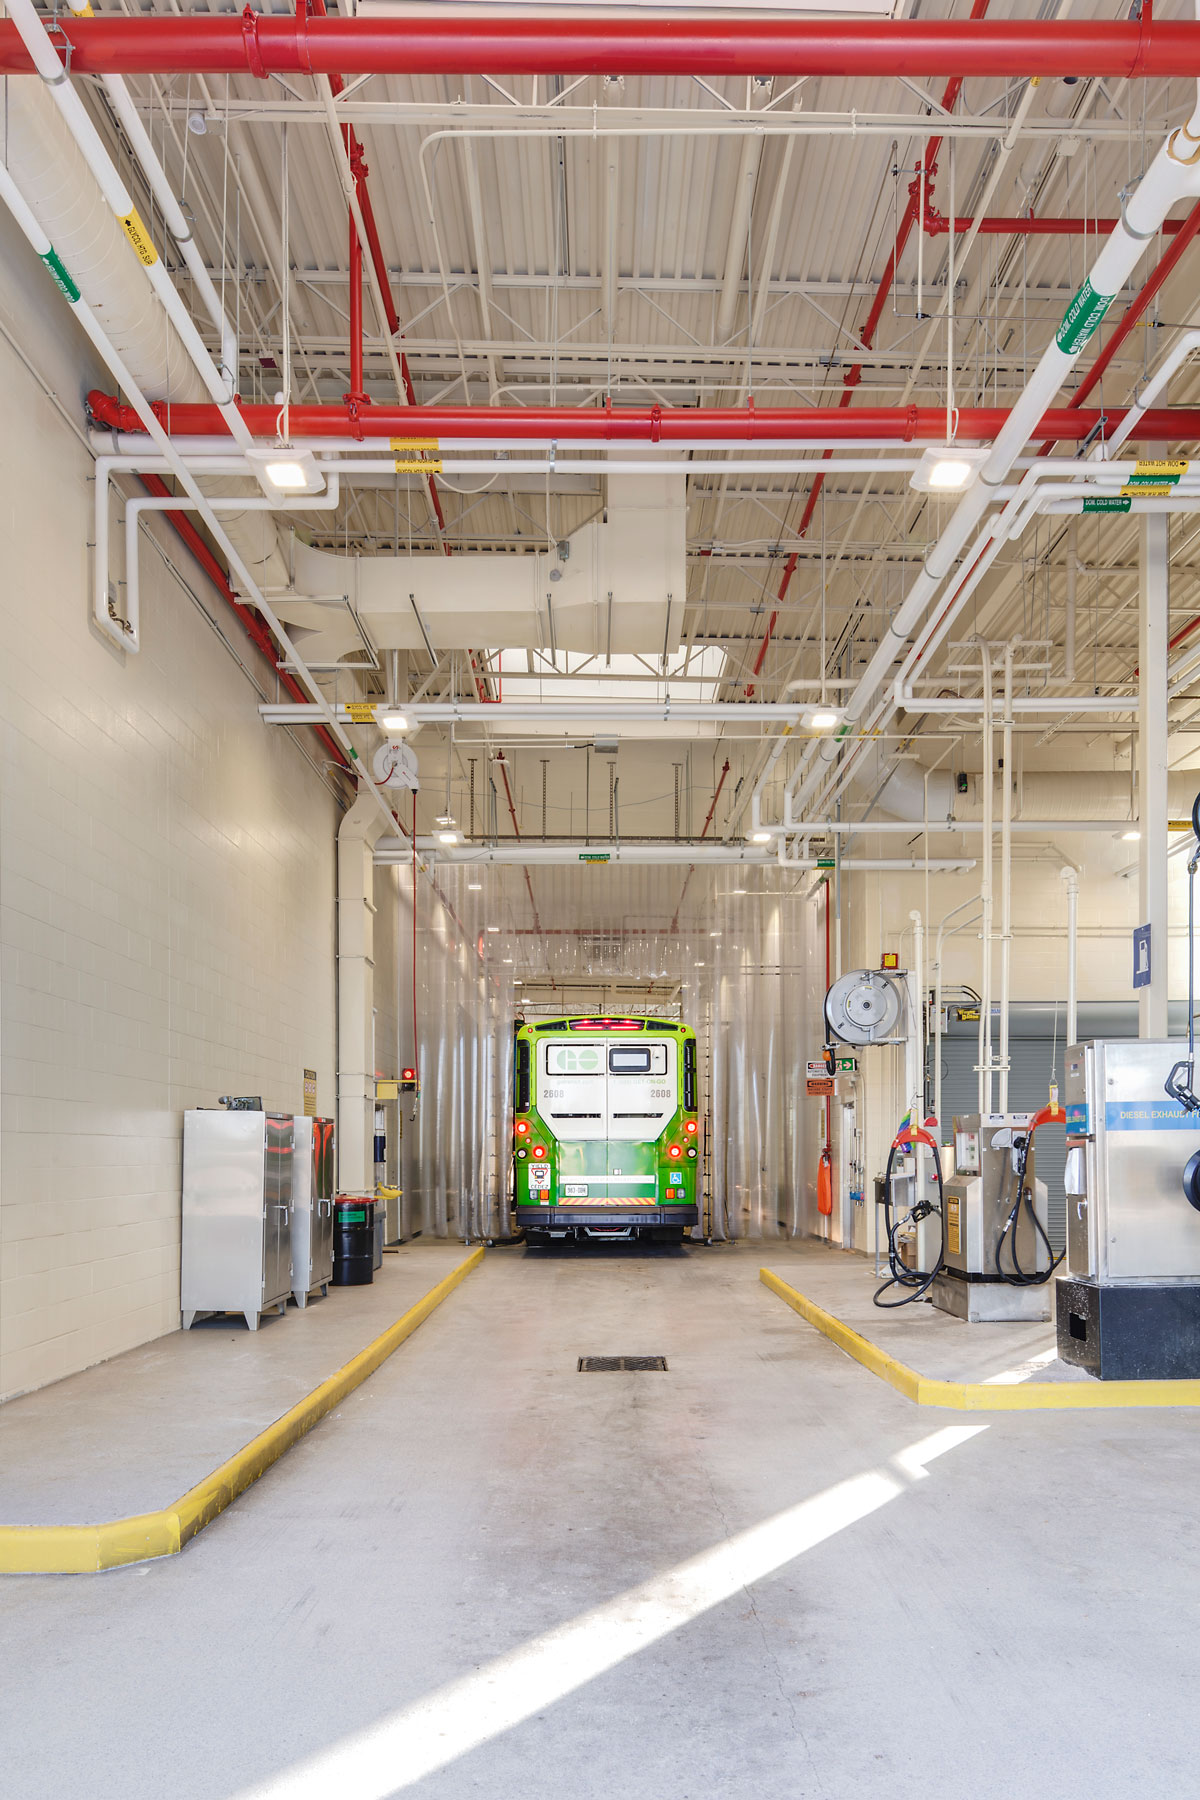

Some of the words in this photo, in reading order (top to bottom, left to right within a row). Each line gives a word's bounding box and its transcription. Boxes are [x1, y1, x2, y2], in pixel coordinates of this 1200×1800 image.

[127, 226, 141, 245] GLYCOL
[142, 255, 153, 265] SUP
[1068, 303, 1080, 323] COLD
[1077, 283, 1092, 308] WATER
[1084, 312, 1101, 328] COLD
[1071, 328, 1092, 346] WATER
[556, 1049, 599, 1070] GO
[543, 1089, 565, 1098] 2608
[650, 1089, 671, 1098] 2608
[1120, 1110, 1148, 1119] DIESEL
[1151, 1110, 1189, 1119] EXHAUST
